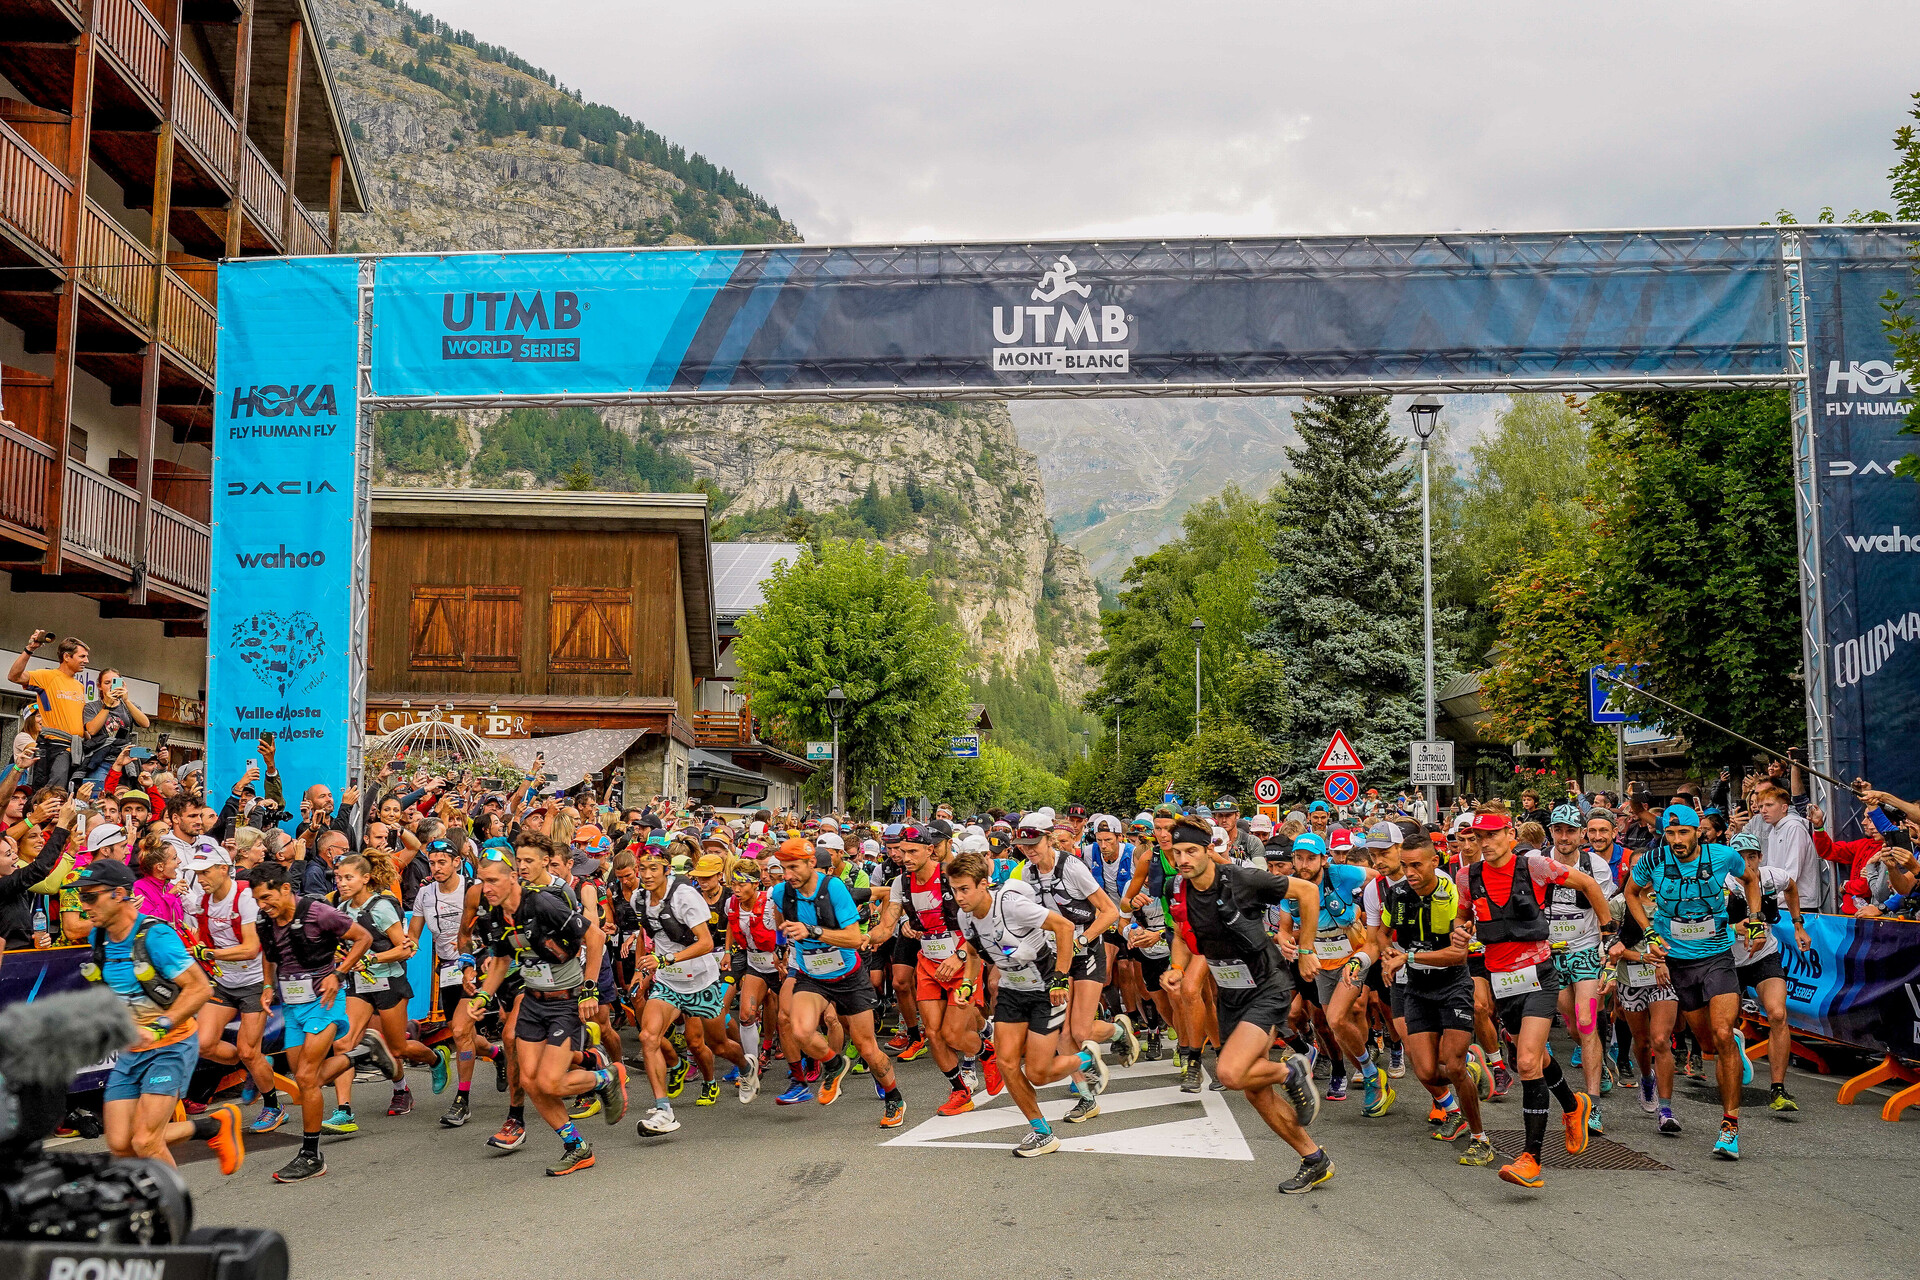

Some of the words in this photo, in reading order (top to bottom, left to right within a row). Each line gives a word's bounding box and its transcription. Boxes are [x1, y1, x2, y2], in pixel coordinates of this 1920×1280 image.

[447, 340, 512, 355] WORLD
[519, 343, 576, 358] SERIES
[230, 384, 338, 419] HOKA
[1826, 402, 1854, 416] FLY
[229, 426, 250, 439] FLY
[251, 425, 311, 438] HUMAN
[314, 424, 337, 437] FLY
[227, 479, 338, 496] DACIA
[235, 544, 326, 569] wahoo
[235, 706, 274, 722] Valle
[1418, 754, 1446, 762] CONTROLLO
[1417, 763, 1448, 772] ELETTRONICO
[1413, 773, 1428, 781] DELLA
[1260, 784, 1276, 797] 30
[811, 957, 833, 967] 3065
[1218, 971, 1240, 979] 3137
[1636, 969, 1656, 977] 309
[1500, 974, 1526, 987] 3141
[1793, 985, 1815, 1000] SERIES
[149, 1075, 172, 1084] HOKA
